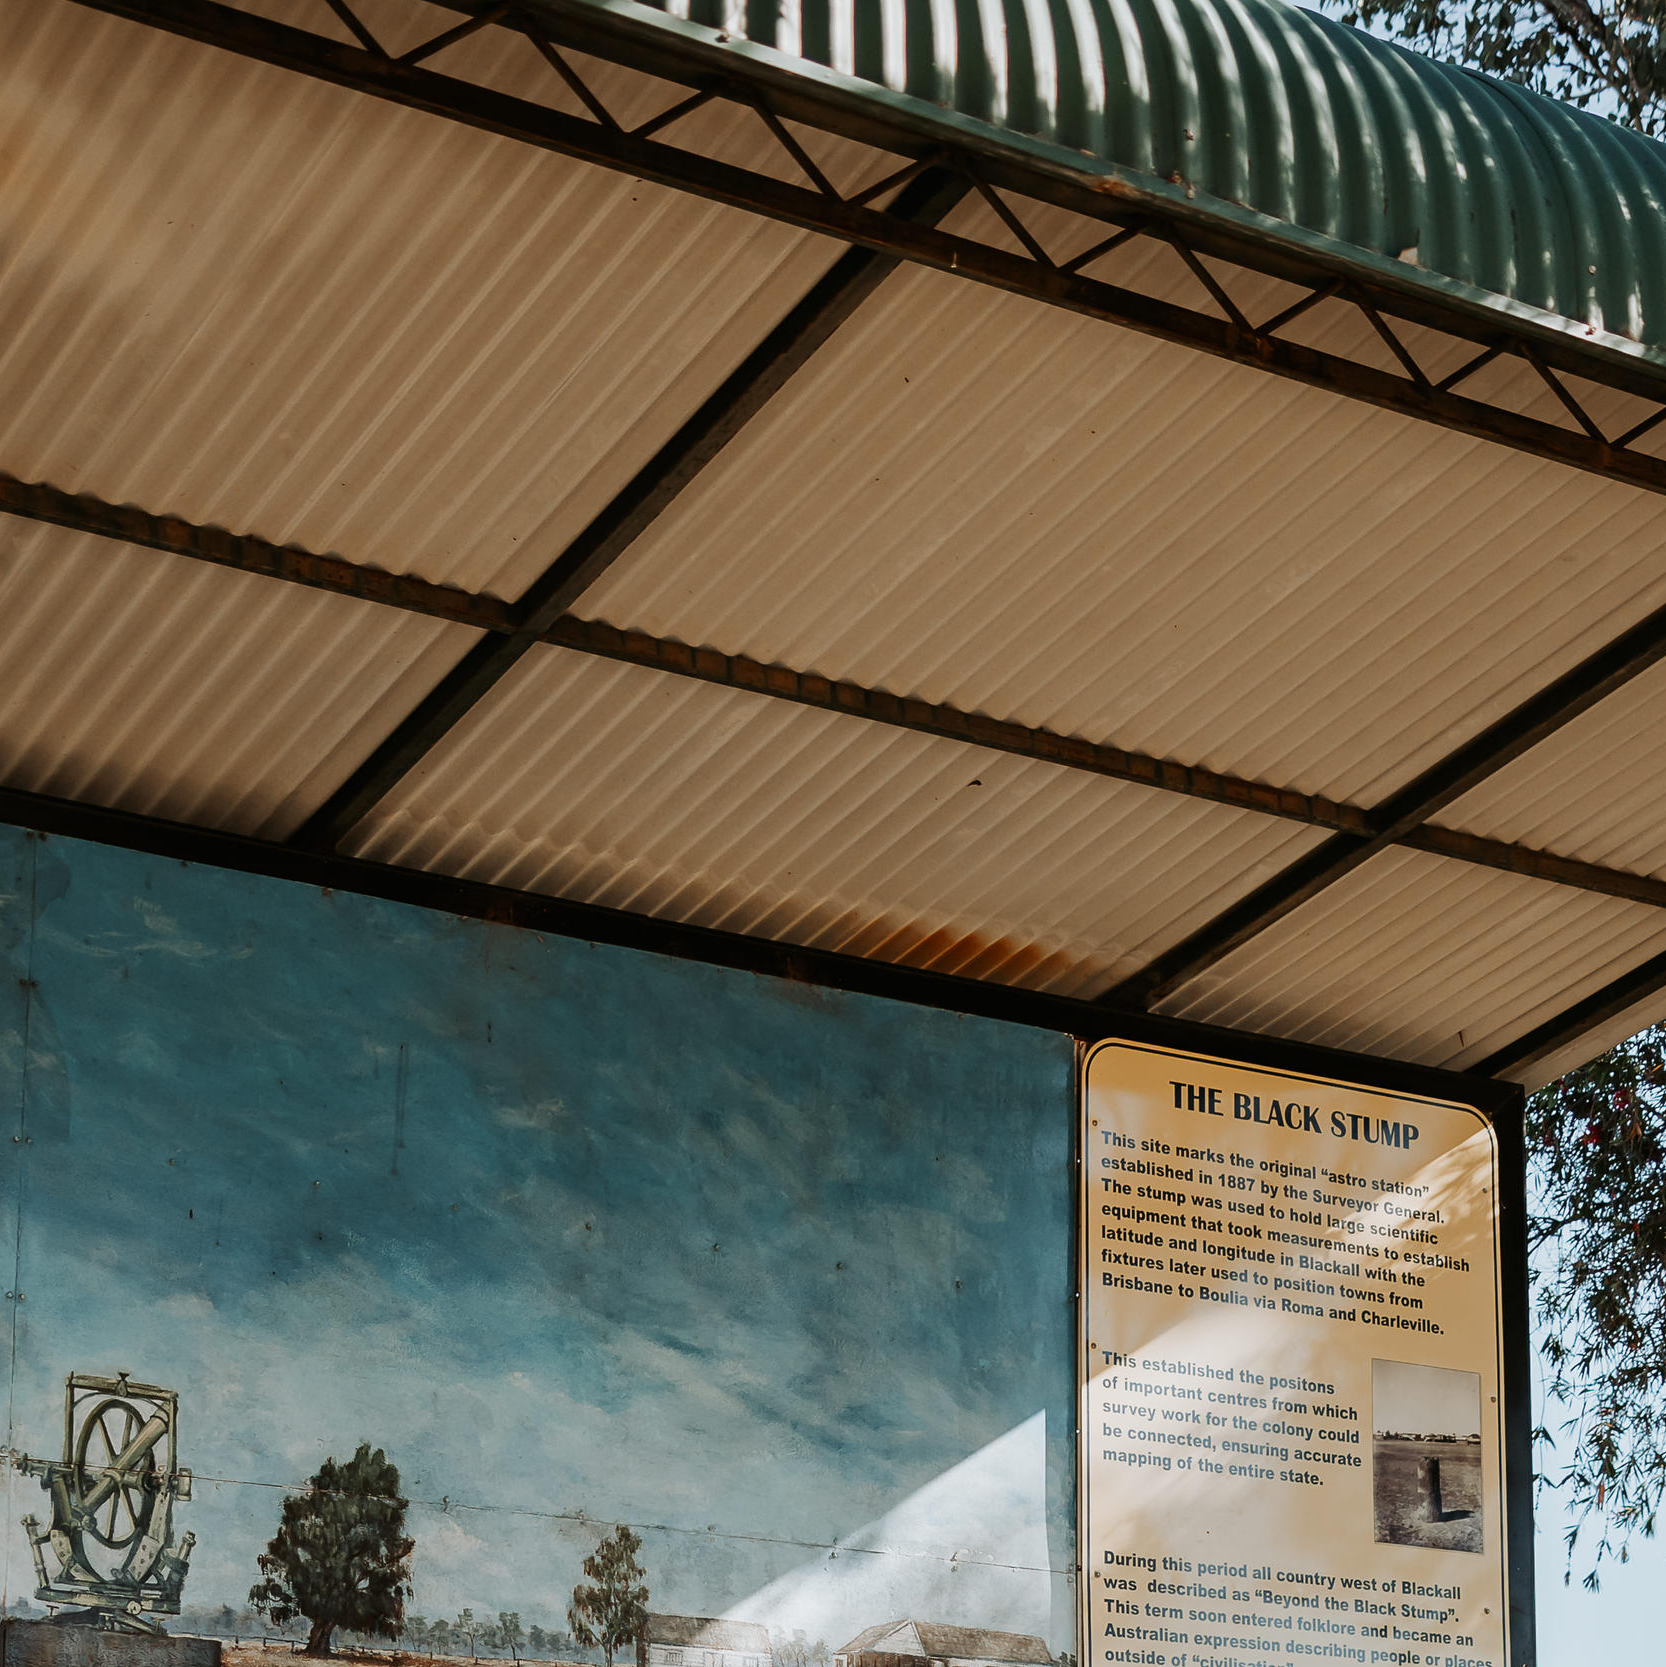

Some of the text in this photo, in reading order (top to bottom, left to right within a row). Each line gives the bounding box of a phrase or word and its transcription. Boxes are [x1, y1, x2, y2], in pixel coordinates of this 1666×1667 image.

[1169, 1081, 1419, 1149] THE BLACK STUMP
[1101, 1131, 1429, 1197] This site marks the original “astro station”
[1102, 1158, 1444, 1223] established in 1887 by the Surveyor General.
[1101, 1178, 1437, 1244] The stump was used to hold large scientific
[1102, 1205, 1469, 1272] equipment that took measurements to establish
[1101, 1249, 1422, 1309] fixtures later used to position towns from
[1102, 1225, 1425, 1287] latitude and longitude in Blackall with the
[1103, 1272, 1443, 1335] Brisbane to Boulia via Roma and Charleville.
[1103, 1351, 1334, 1394] This established the positons
[1103, 1423, 1361, 1467] be connected, ensuring accurate
[1103, 1450, 1323, 1485] mapping of the entire state.
[1104, 1577, 1458, 1624] was described as “Beyond the Black Stump”.
[1105, 1551, 1460, 1599] During this period all country west of Blackall
[1104, 1599, 1473, 1646] This term soon entered folklore and became an
[1105, 1650, 1165, 1665] outside
[1172, 1654, 1187, 1667] of
